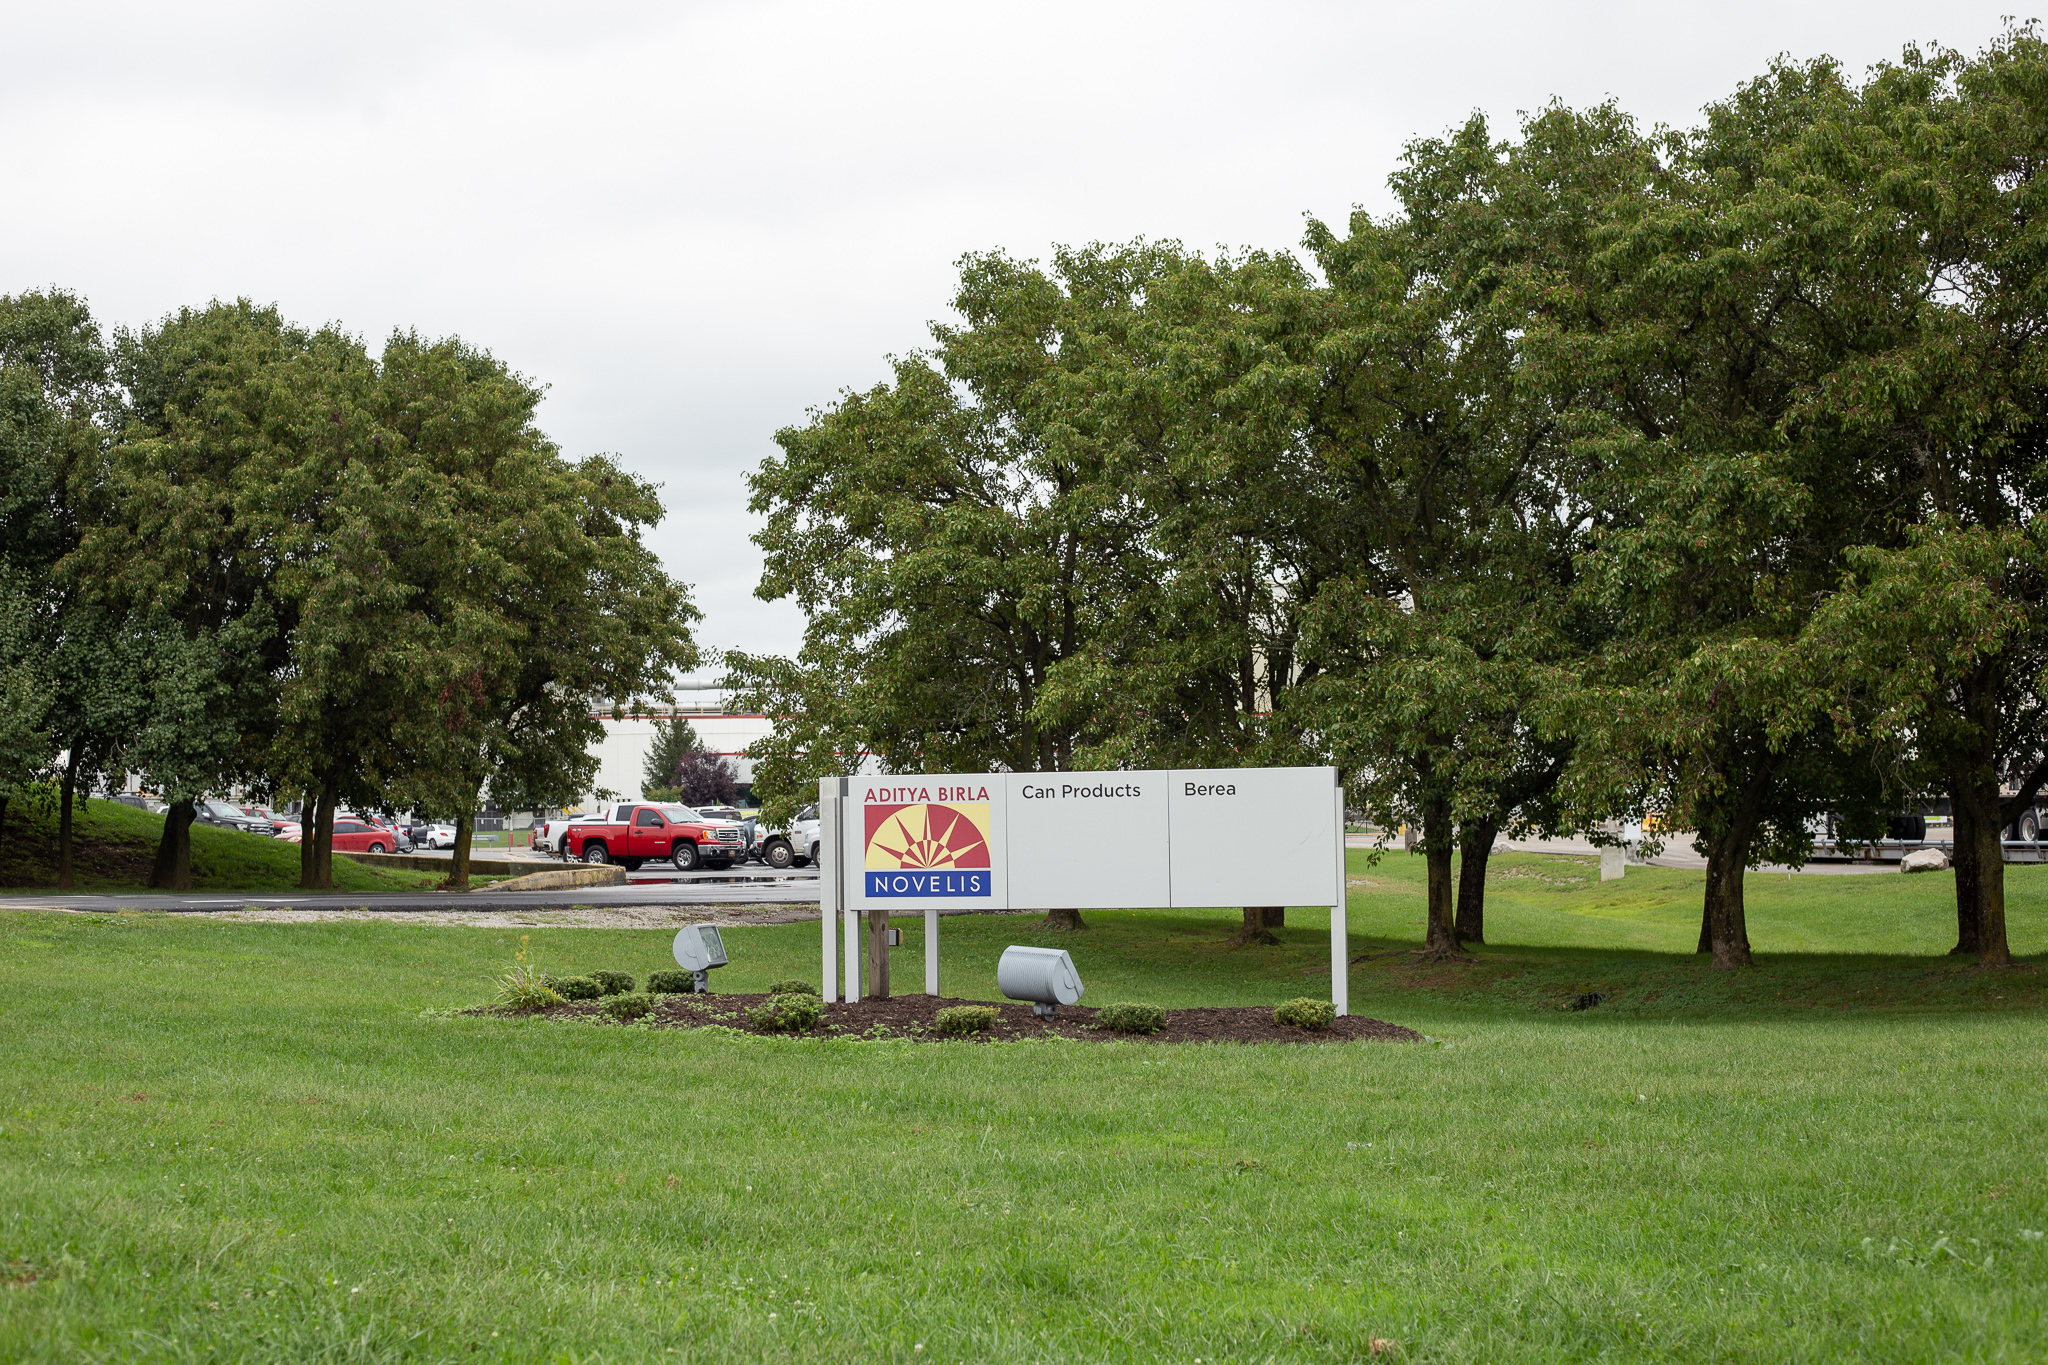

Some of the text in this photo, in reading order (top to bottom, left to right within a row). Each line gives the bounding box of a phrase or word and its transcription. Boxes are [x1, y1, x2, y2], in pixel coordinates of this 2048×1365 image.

[864, 786, 990, 803] ADITYA BIRLA
[1022, 783, 1141, 799] Can Products
[1184, 782, 1236, 796] Berea
[875, 875, 981, 893] NOVELIS
